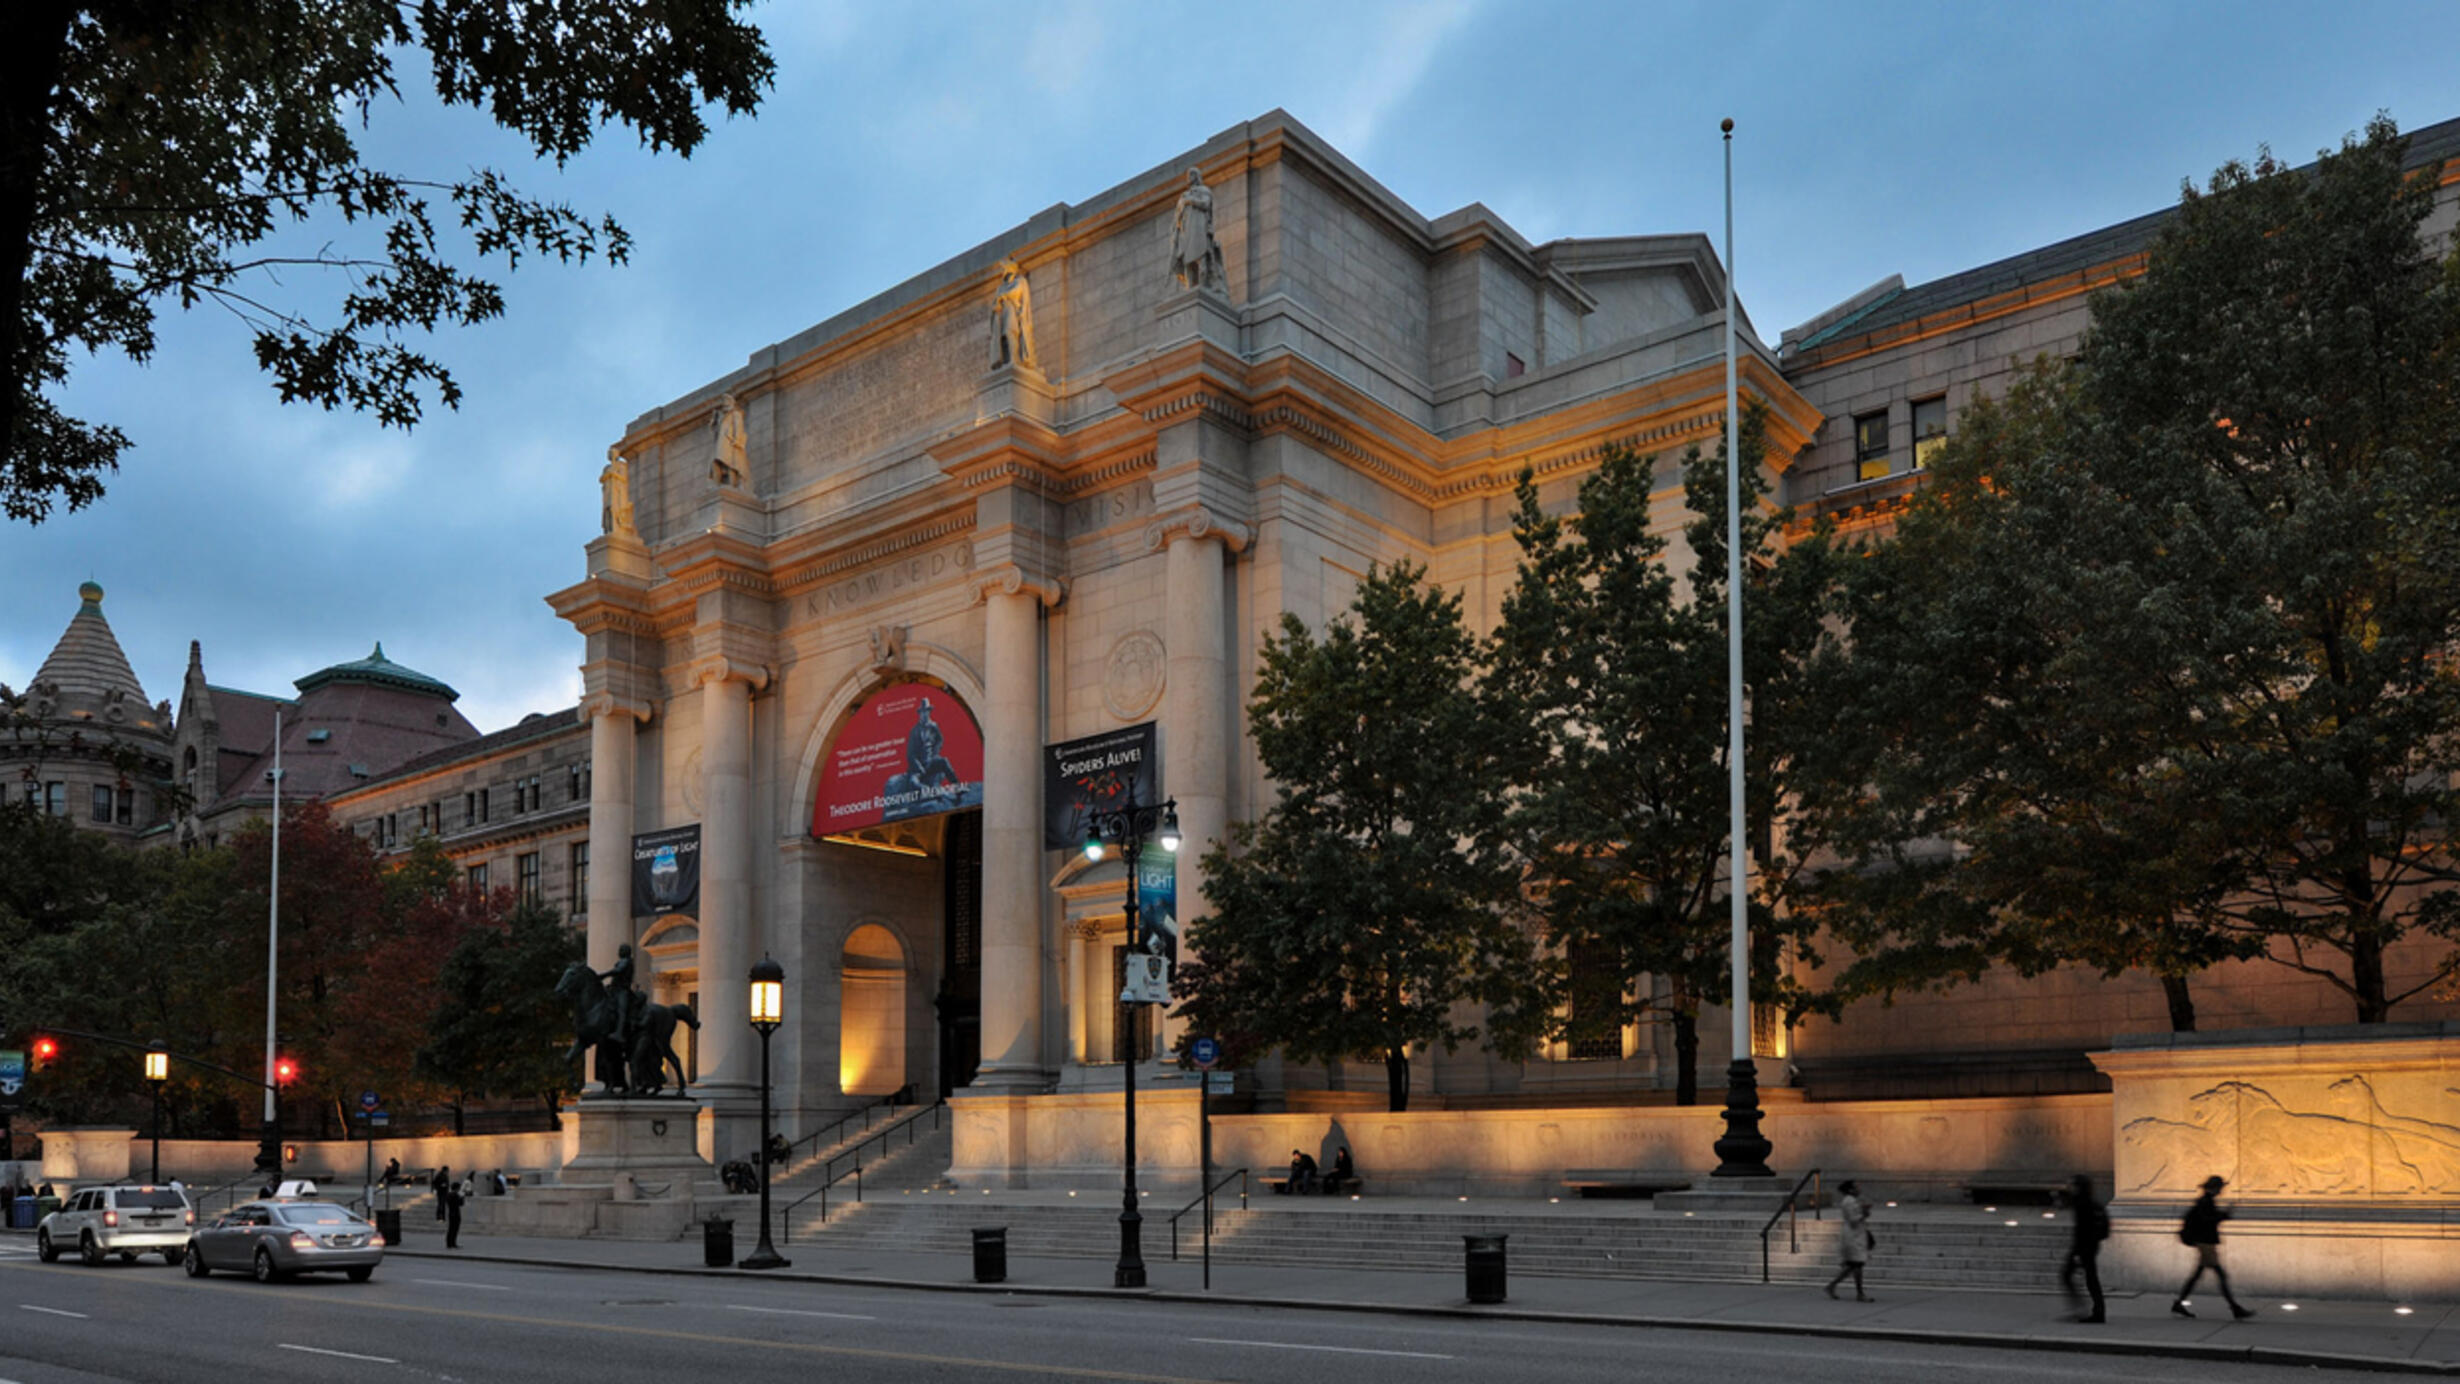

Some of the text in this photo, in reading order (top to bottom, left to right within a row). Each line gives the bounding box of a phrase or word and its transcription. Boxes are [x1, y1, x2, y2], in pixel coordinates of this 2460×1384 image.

[1060, 747, 1142, 777] SPIDERS ALIVE!
[830, 801, 871, 817] THEODORE
[874, 790, 919, 808] ROOSEVELT
[921, 781, 970, 797] MEMORIAL
[1140, 871, 1173, 889] LIGHT
